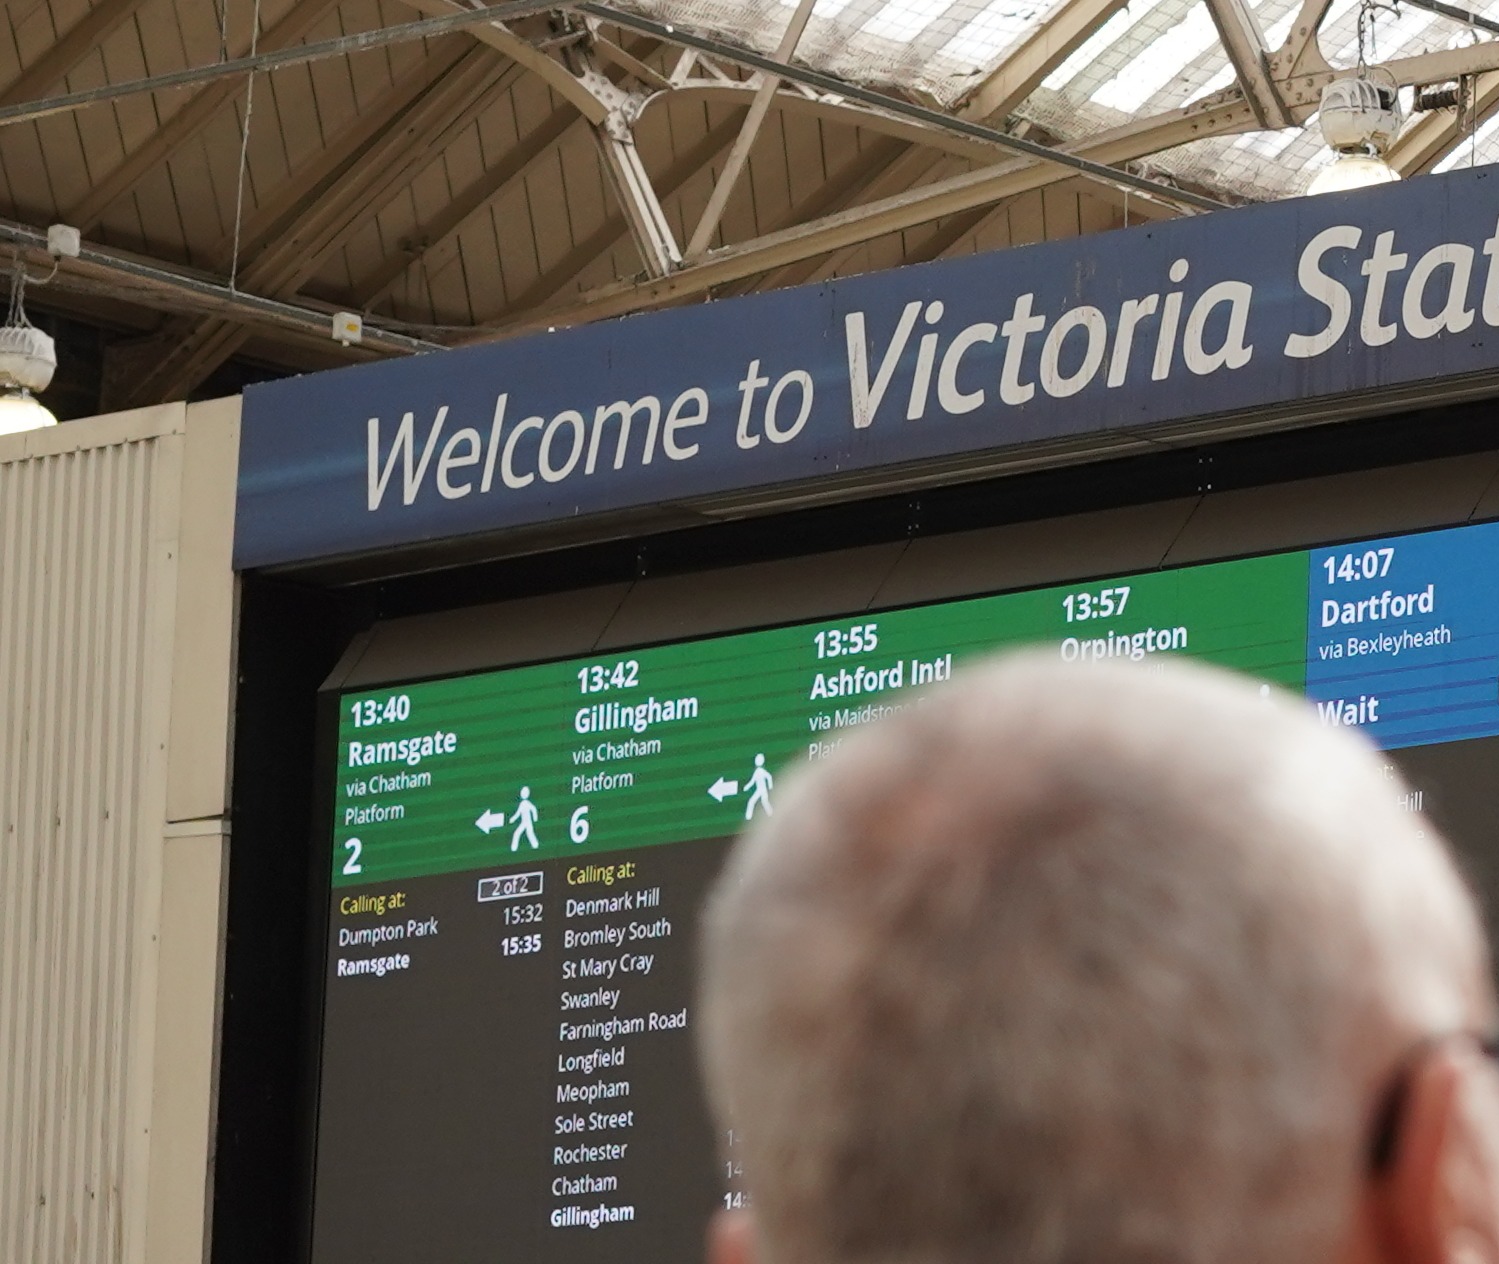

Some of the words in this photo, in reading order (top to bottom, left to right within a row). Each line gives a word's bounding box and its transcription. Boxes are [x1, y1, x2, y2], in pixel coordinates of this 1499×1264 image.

[367, 386, 708, 511] Welcome
[736, 359, 814, 450] to
[845, 258, 1253, 429] Victoria
[1323, 547, 1395, 585] 14:07
[1062, 586, 1131, 623] 13:57
[1321, 584, 1434, 628] Dartford
[814, 623, 878, 659] 13:55
[1319, 643, 1343, 660] via
[1347, 624, 1451, 657] Bexleyheath
[577, 660, 639, 694] 13:42
[809, 660, 904, 700] Ashford
[912, 653, 952, 686] Intl
[351, 694, 411, 728] 13:40
[574, 696, 698, 734] Gillingham
[1317, 696, 1379, 728] Wait
[348, 730, 457, 767] Ramsgate
[572, 748, 594, 765] via
[596, 738, 662, 762] Chatham
[346, 781, 367, 797] via
[368, 771, 432, 794] Chatham
[571, 771, 634, 794] Platform
[345, 803, 405, 826] Platform
[570, 805, 590, 844] 6
[342, 837, 362, 875] 2
[340, 895, 386, 916] Calling
[387, 891, 406, 909] at:
[565, 896, 631, 918] Denmark
[635, 888, 660, 910] Hill
[338, 924, 404, 947] Dumpton
[406, 916, 439, 938] Park
[503, 902, 543, 925] 15:32
[564, 924, 626, 949] Bromley
[628, 917, 671, 941] South
[337, 953, 410, 977] Ramsgate
[501, 933, 542, 956] 15:35
[562, 960, 577, 980] St
[579, 957, 618, 980] Mary
[619, 953, 655, 975] Cray
[560, 986, 621, 1011] Swanley
[556, 1079, 630, 1105] Meopham
[553, 1143, 628, 1165] Rochester
